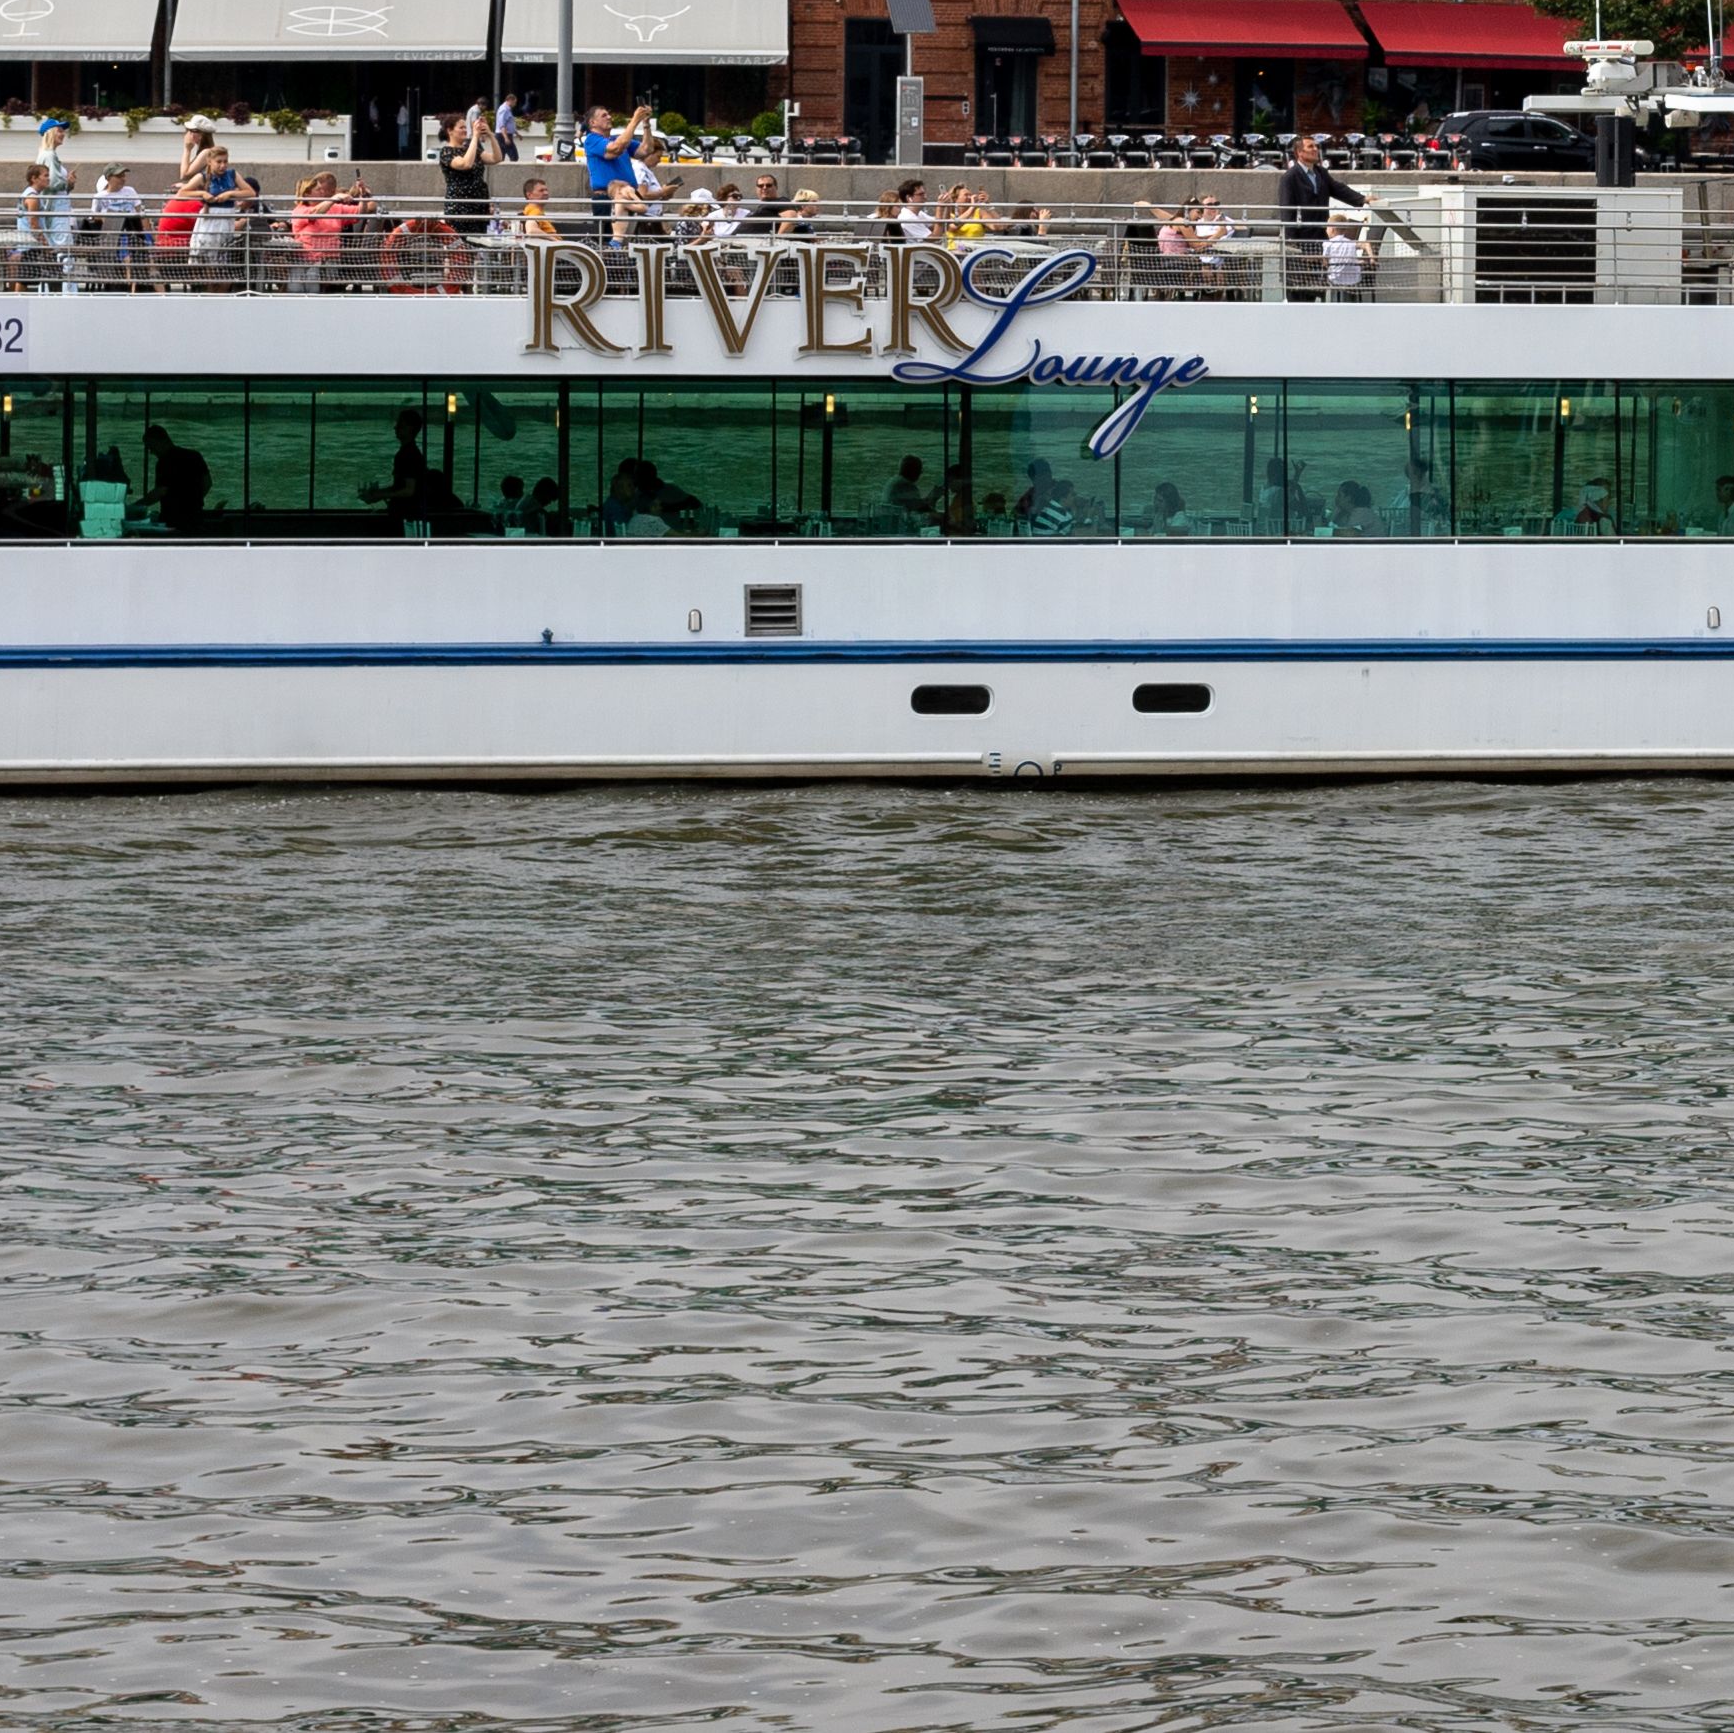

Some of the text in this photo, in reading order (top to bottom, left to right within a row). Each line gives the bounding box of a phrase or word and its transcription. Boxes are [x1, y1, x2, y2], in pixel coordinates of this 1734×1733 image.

[82, 52, 139, 61] VINERIA
[525, 242, 976, 356] RIVER
[892, 247, 1210, 459] Lounge
